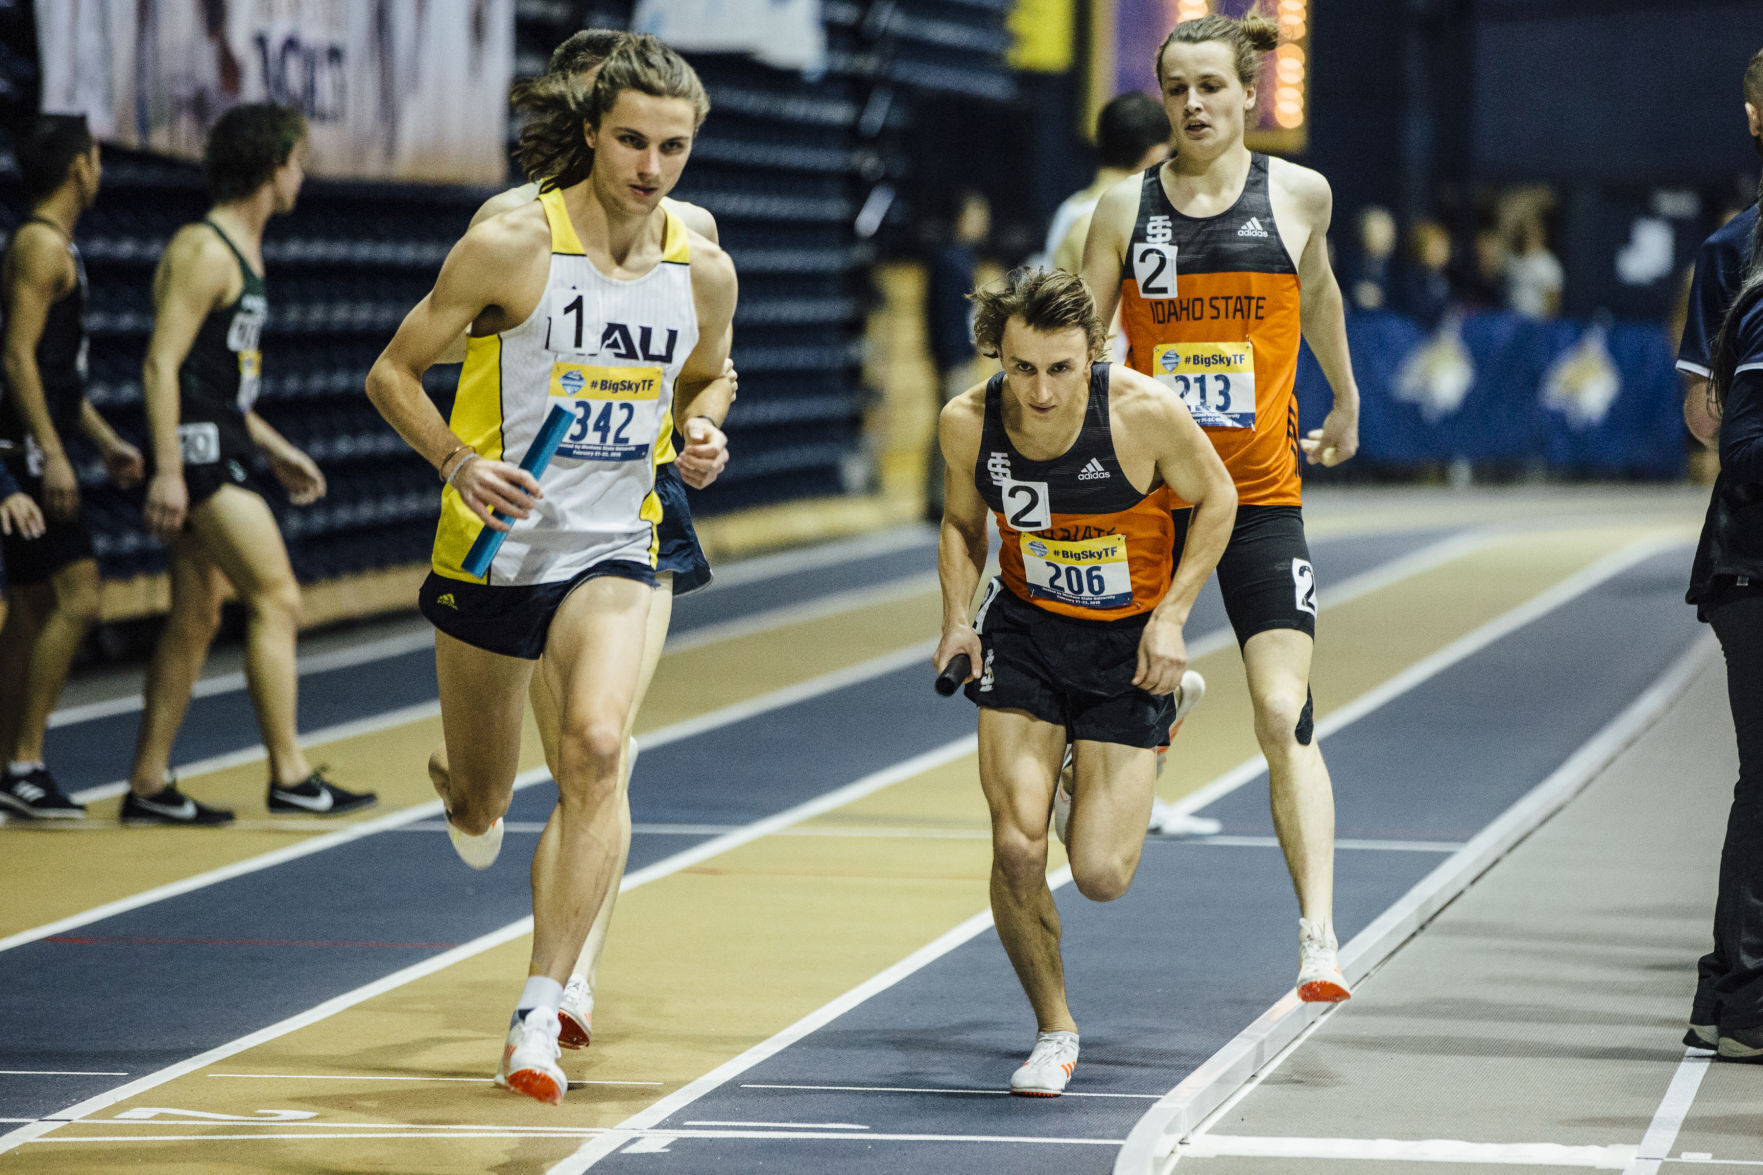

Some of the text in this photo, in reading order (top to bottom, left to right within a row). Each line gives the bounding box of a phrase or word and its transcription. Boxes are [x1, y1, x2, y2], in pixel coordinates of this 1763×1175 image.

[1238, 228, 1268, 238] adidas
[1138, 247, 1169, 295] 2
[563, 295, 584, 349] 1
[1150, 295, 1267, 325] IDAHO STATE
[1184, 353, 1246, 367] #BigSkyTF
[590, 379, 654, 394] #BigSkyTF
[1174, 374, 1232, 412] 213
[568, 400, 635, 445] 342
[1077, 470, 1110, 481] adidas
[1007, 485, 1042, 528] 2
[1053, 546, 1118, 561] #BigSkyTF
[1045, 561, 1106, 597] 206
[1298, 564, 1316, 613] 2
